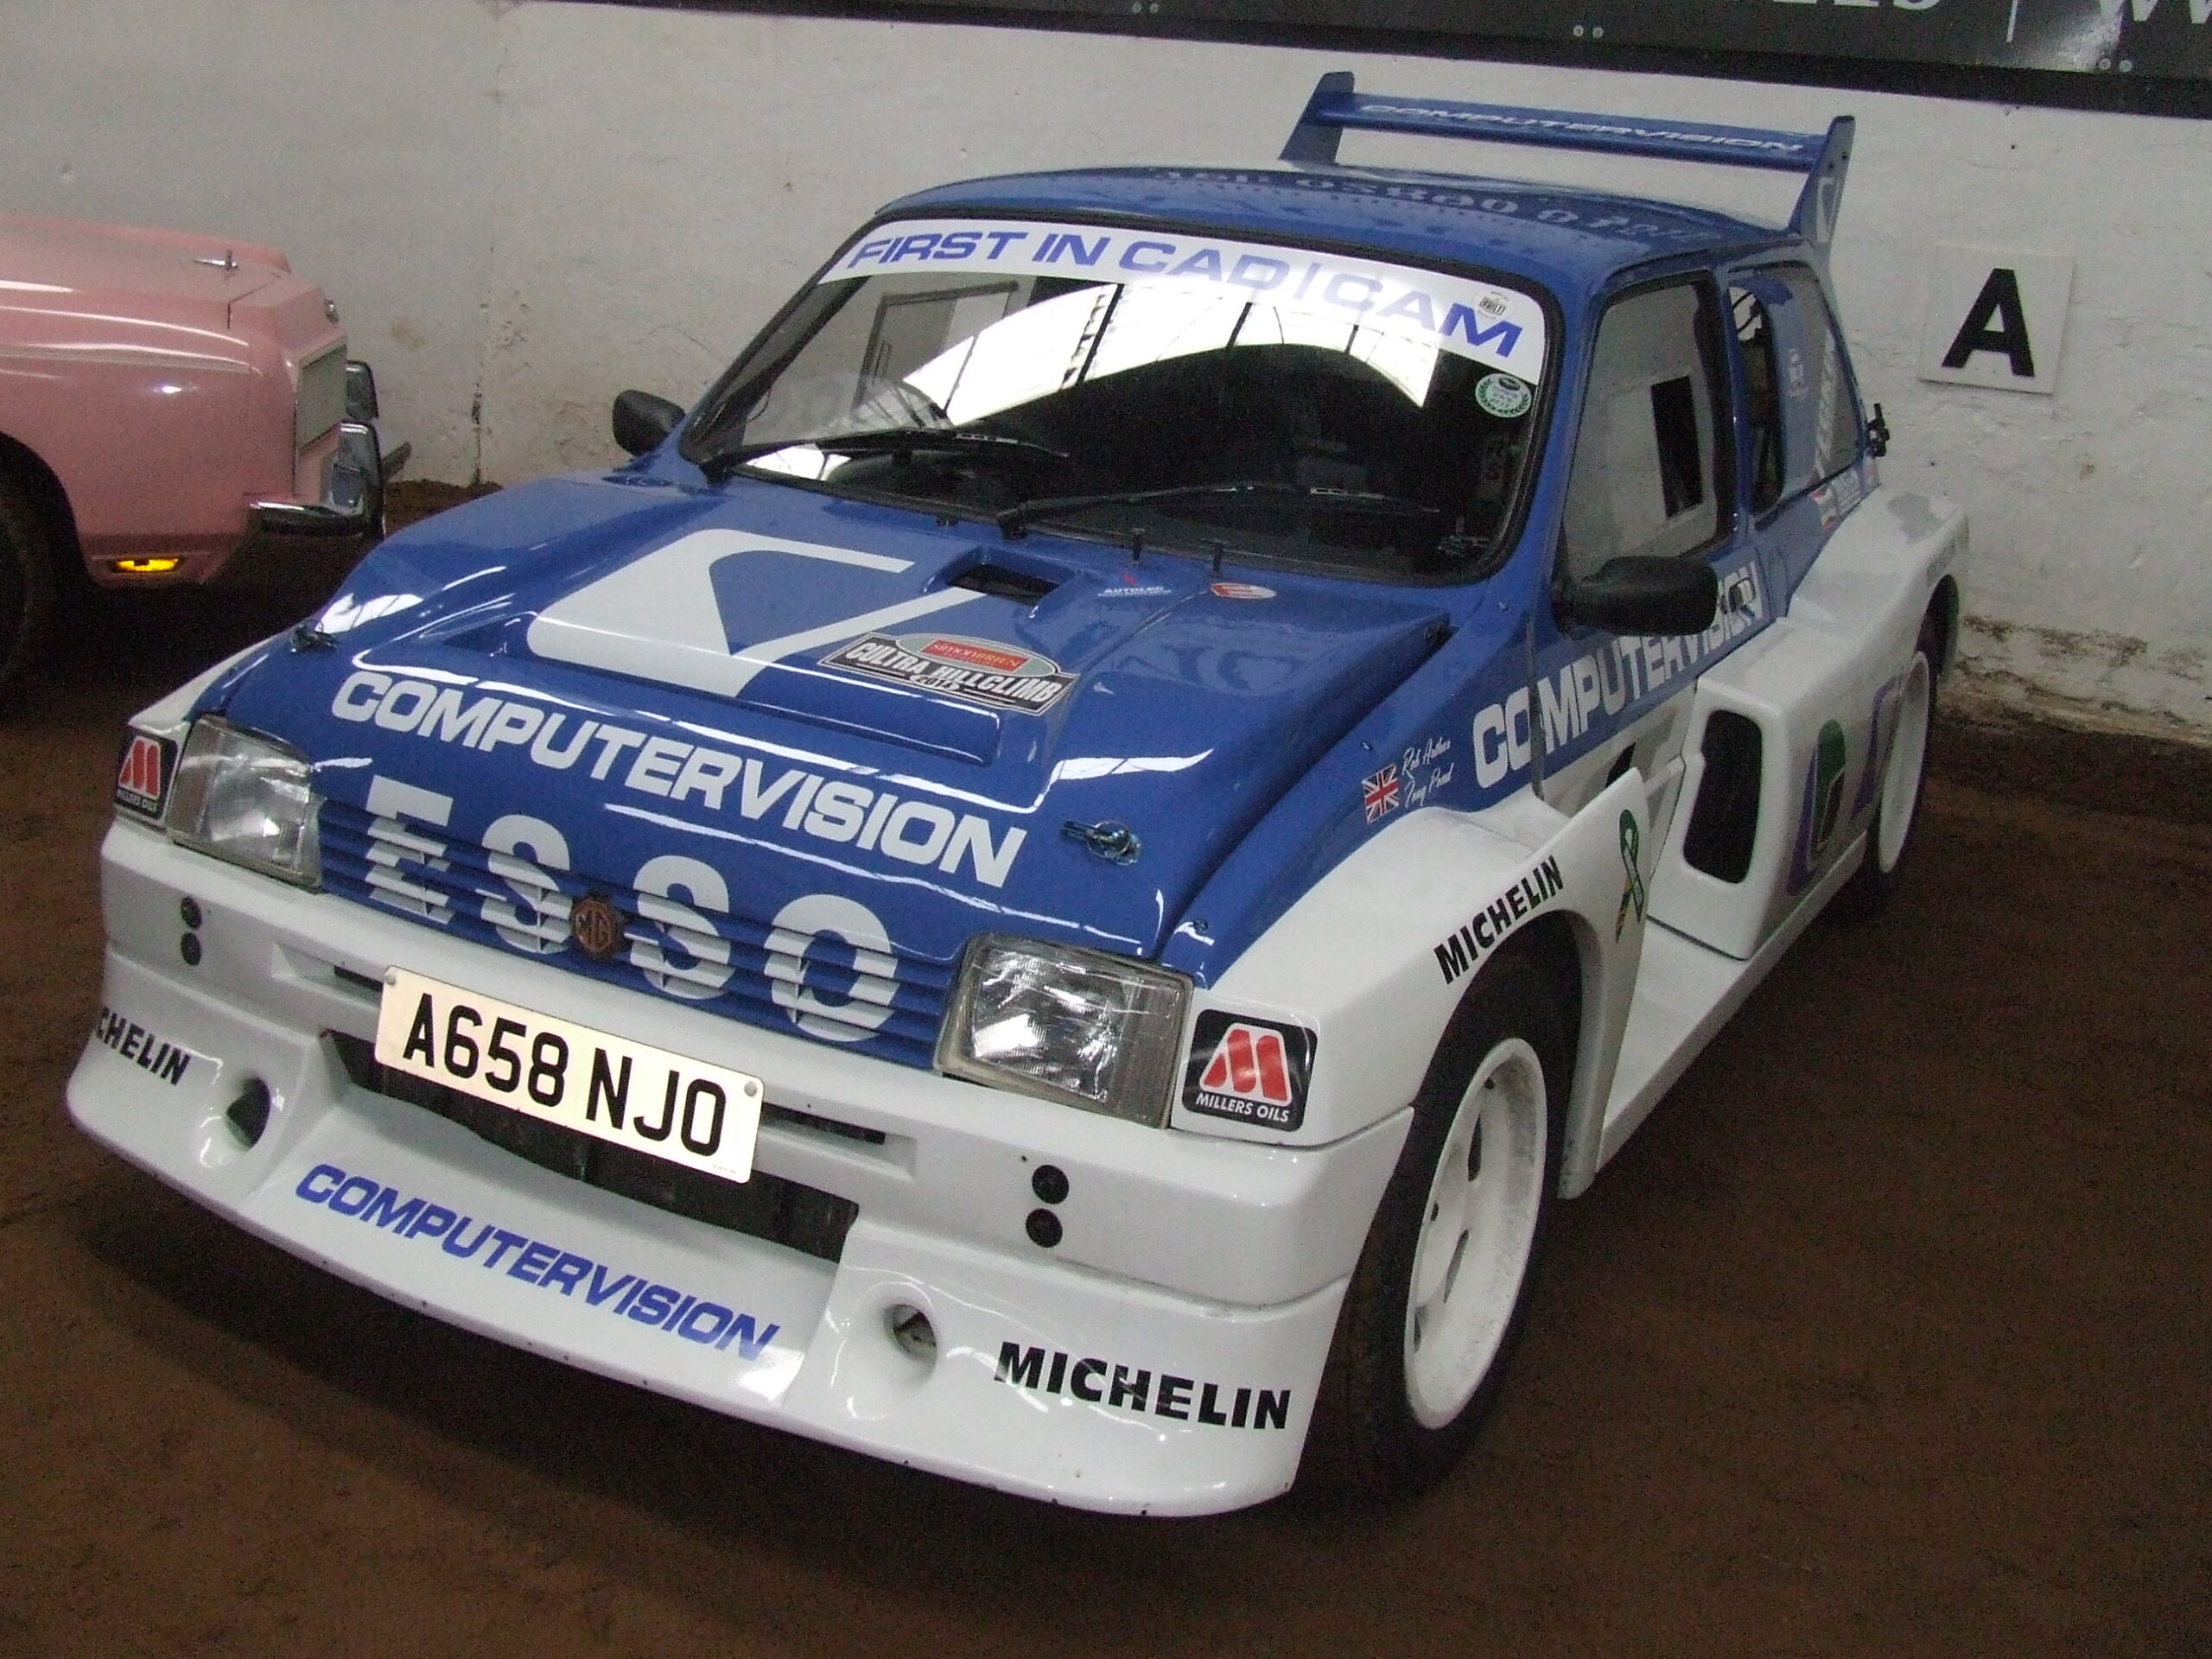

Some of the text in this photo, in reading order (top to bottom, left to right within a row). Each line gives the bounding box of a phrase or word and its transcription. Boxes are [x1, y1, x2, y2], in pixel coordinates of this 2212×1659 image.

[1360, 104, 1804, 152] COMPUTERVISION
[847, 232, 1027, 269] FIRST
[1033, 233, 1111, 265] IN
[1941, 268, 2036, 378] A
[845, 642, 930, 676] CULTRA
[931, 664, 1063, 702] HILLCLIMB
[331, 671, 1028, 887] COMPUTERVISION
[365, 774, 899, 1042] ESSO
[1433, 855, 1564, 985] MICHELIN
[402, 993, 728, 1158] A658 NJO
[1195, 1092, 1290, 1122] MILLERS OILS
[295, 1163, 781, 1362] COMPUTERVISION
[994, 1341, 1293, 1431] MICHELIN
